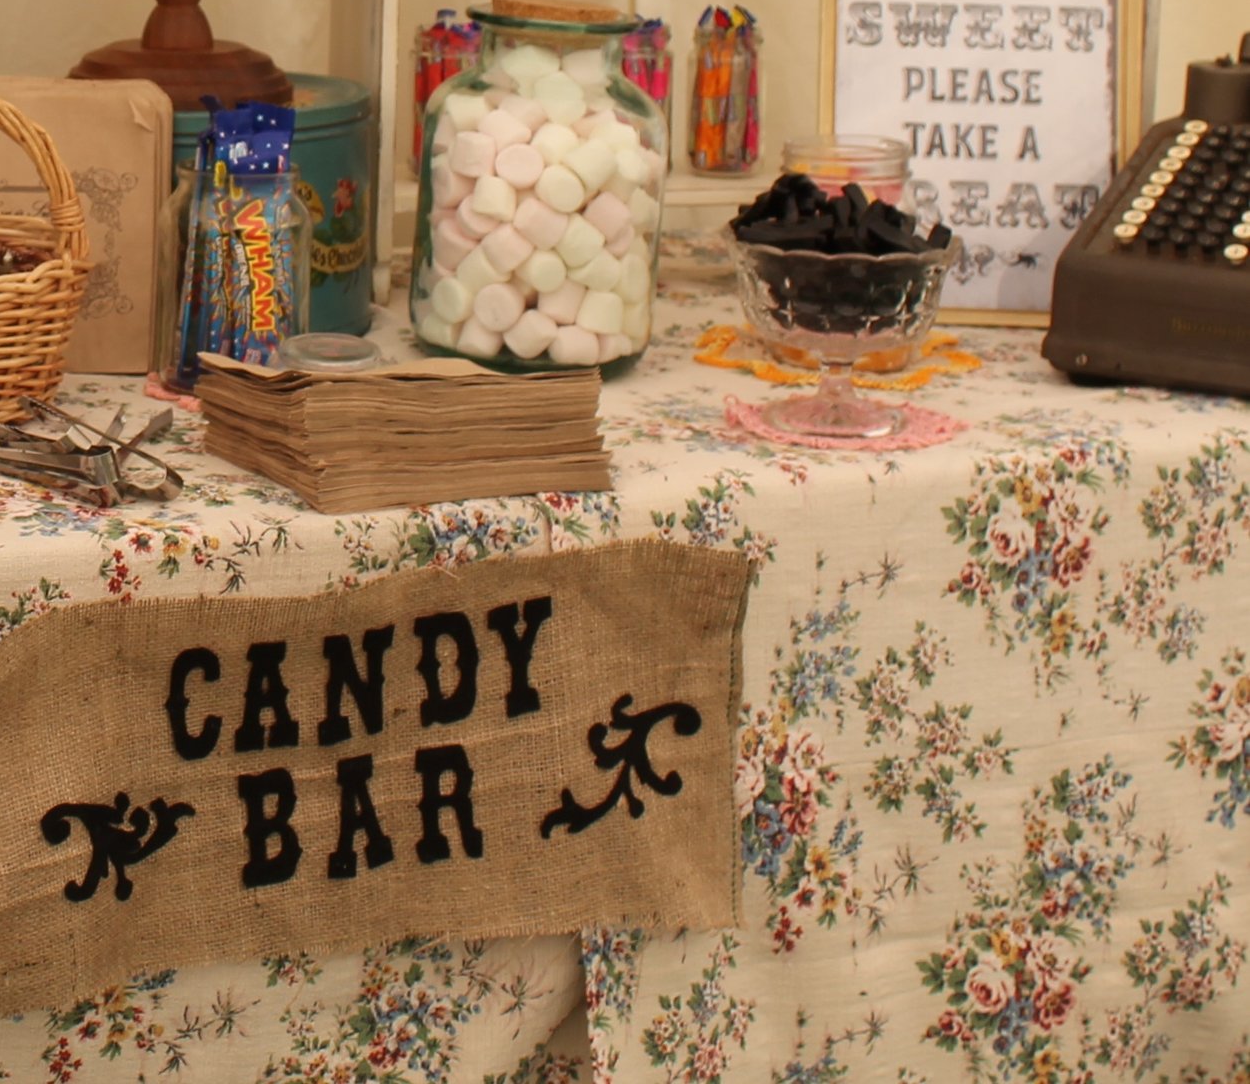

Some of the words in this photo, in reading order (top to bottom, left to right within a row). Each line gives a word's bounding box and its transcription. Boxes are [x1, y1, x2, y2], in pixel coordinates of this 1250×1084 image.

[846, 0, 1105, 52] SWEET
[902, 66, 1044, 106] PLEASE
[904, 122, 1000, 161] TAKE
[1018, 125, 1041, 162] A
[907, 180, 1101, 230] REAT
[234, 199, 275, 331] WHAM
[164, 595, 553, 762] CANDY
[236, 744, 484, 890] BAR
